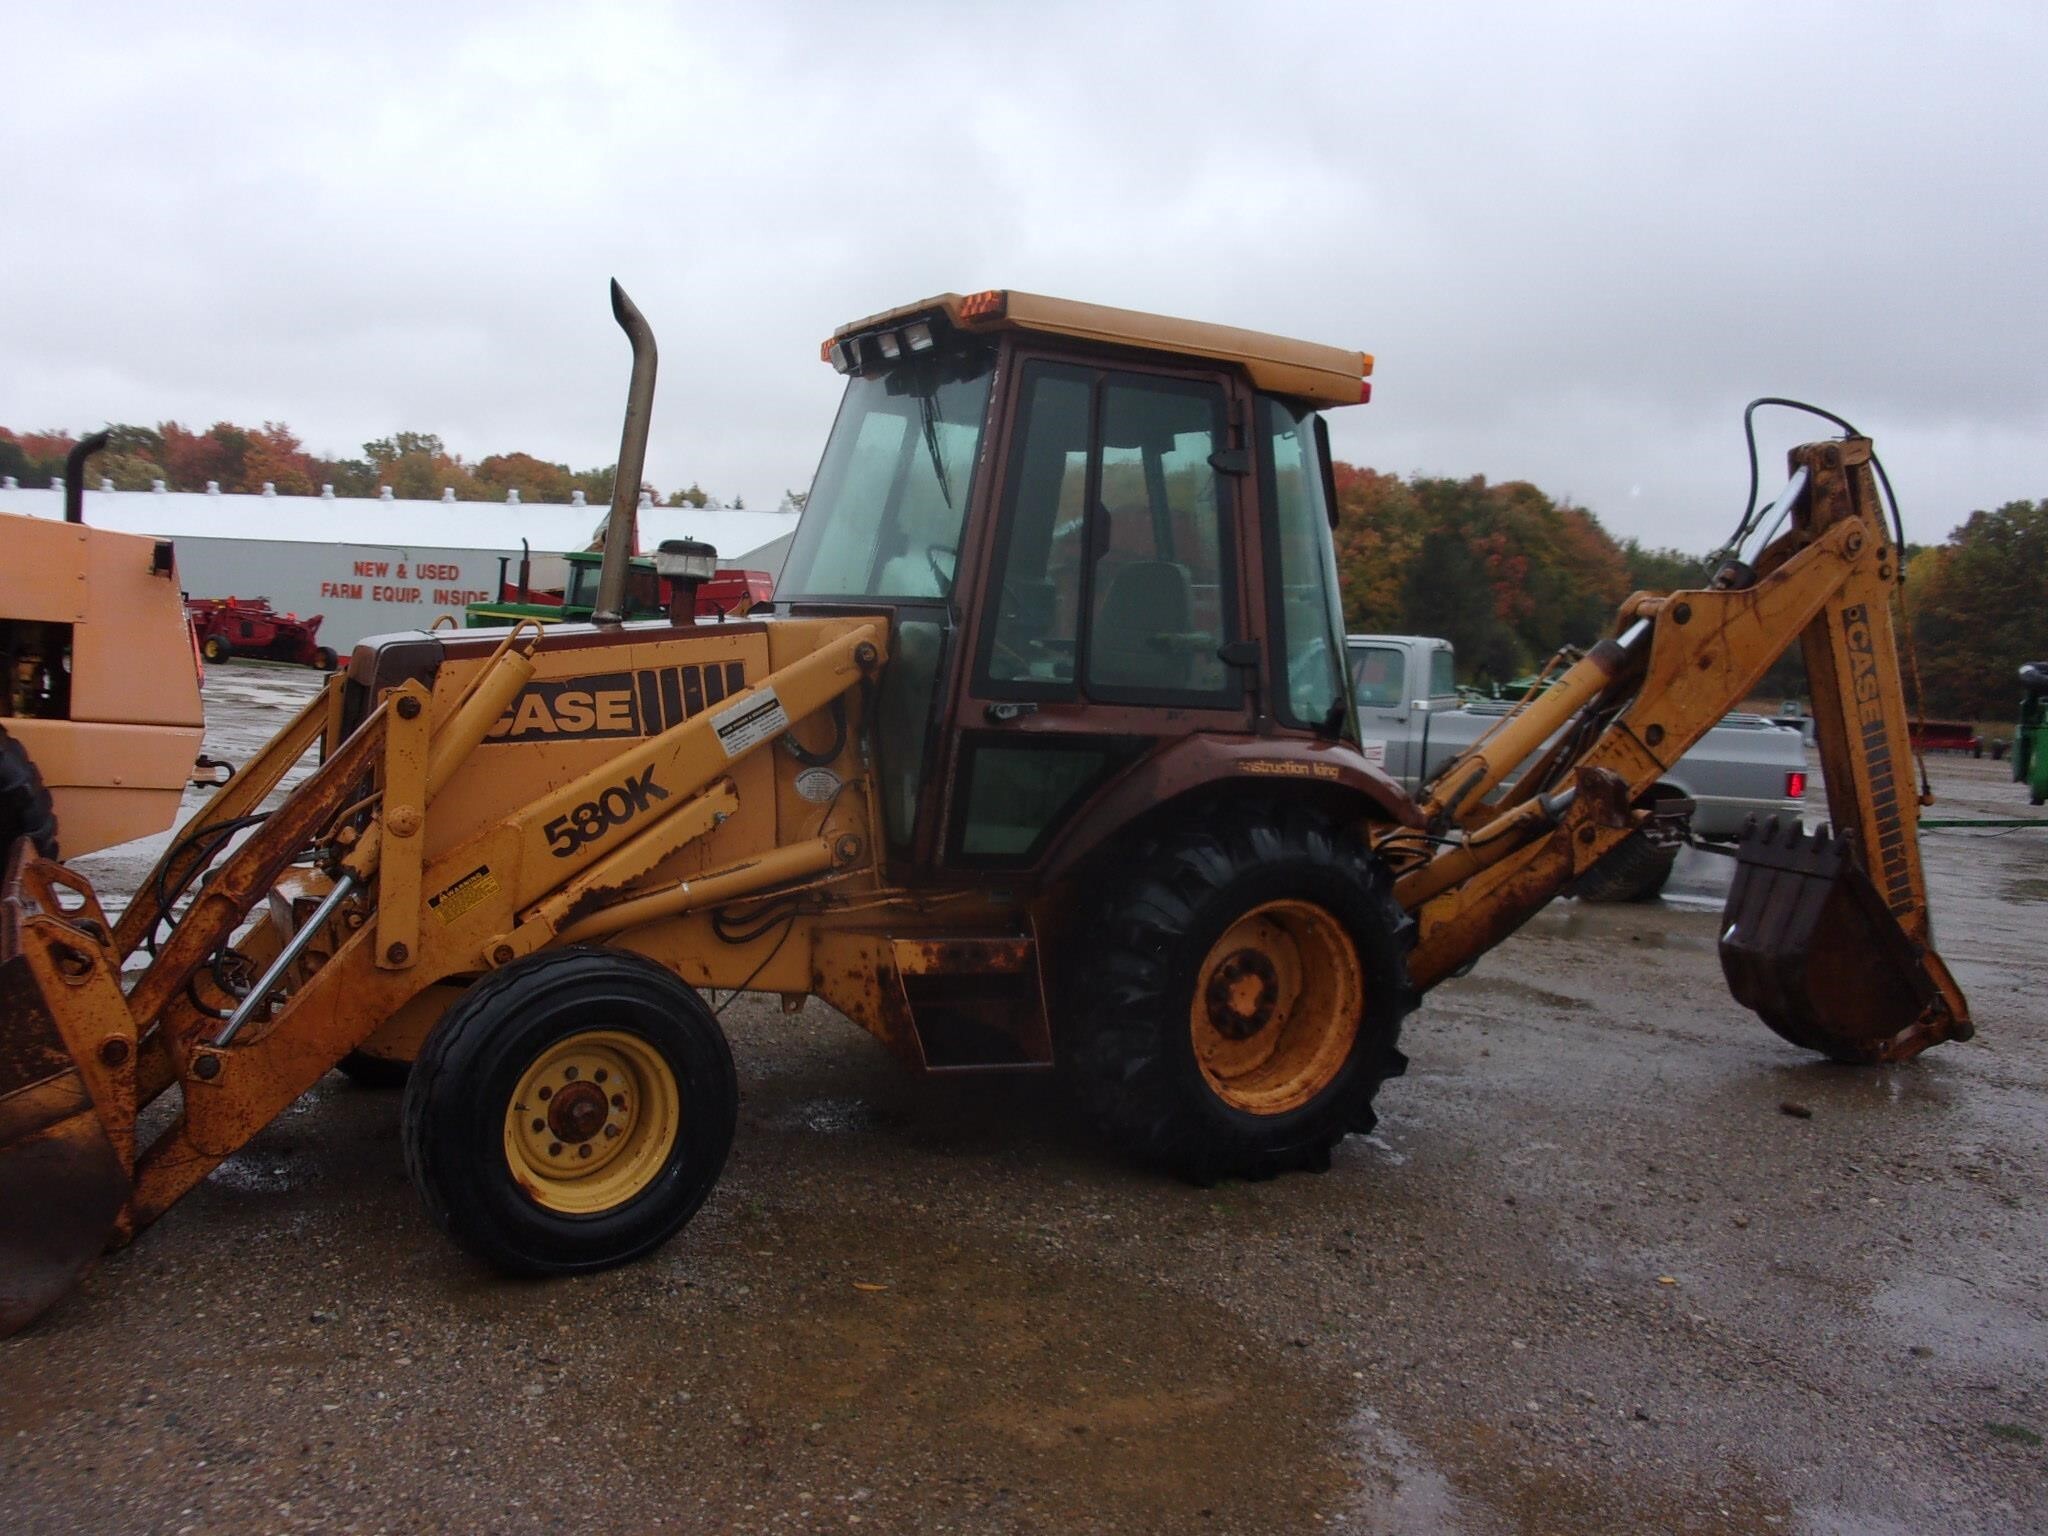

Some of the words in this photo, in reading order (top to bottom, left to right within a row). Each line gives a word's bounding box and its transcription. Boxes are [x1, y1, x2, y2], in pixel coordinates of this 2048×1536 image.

[320, 582, 363, 599] FARM
[373, 585, 433, 604] EQUIP.
[433, 589, 489, 606] INSIDE
[354, 561, 389, 577] NEW
[396, 563, 407, 579] &
[416, 564, 460, 581] USED
[1847, 621, 1884, 726] CASE
[543, 763, 669, 857] 580K
